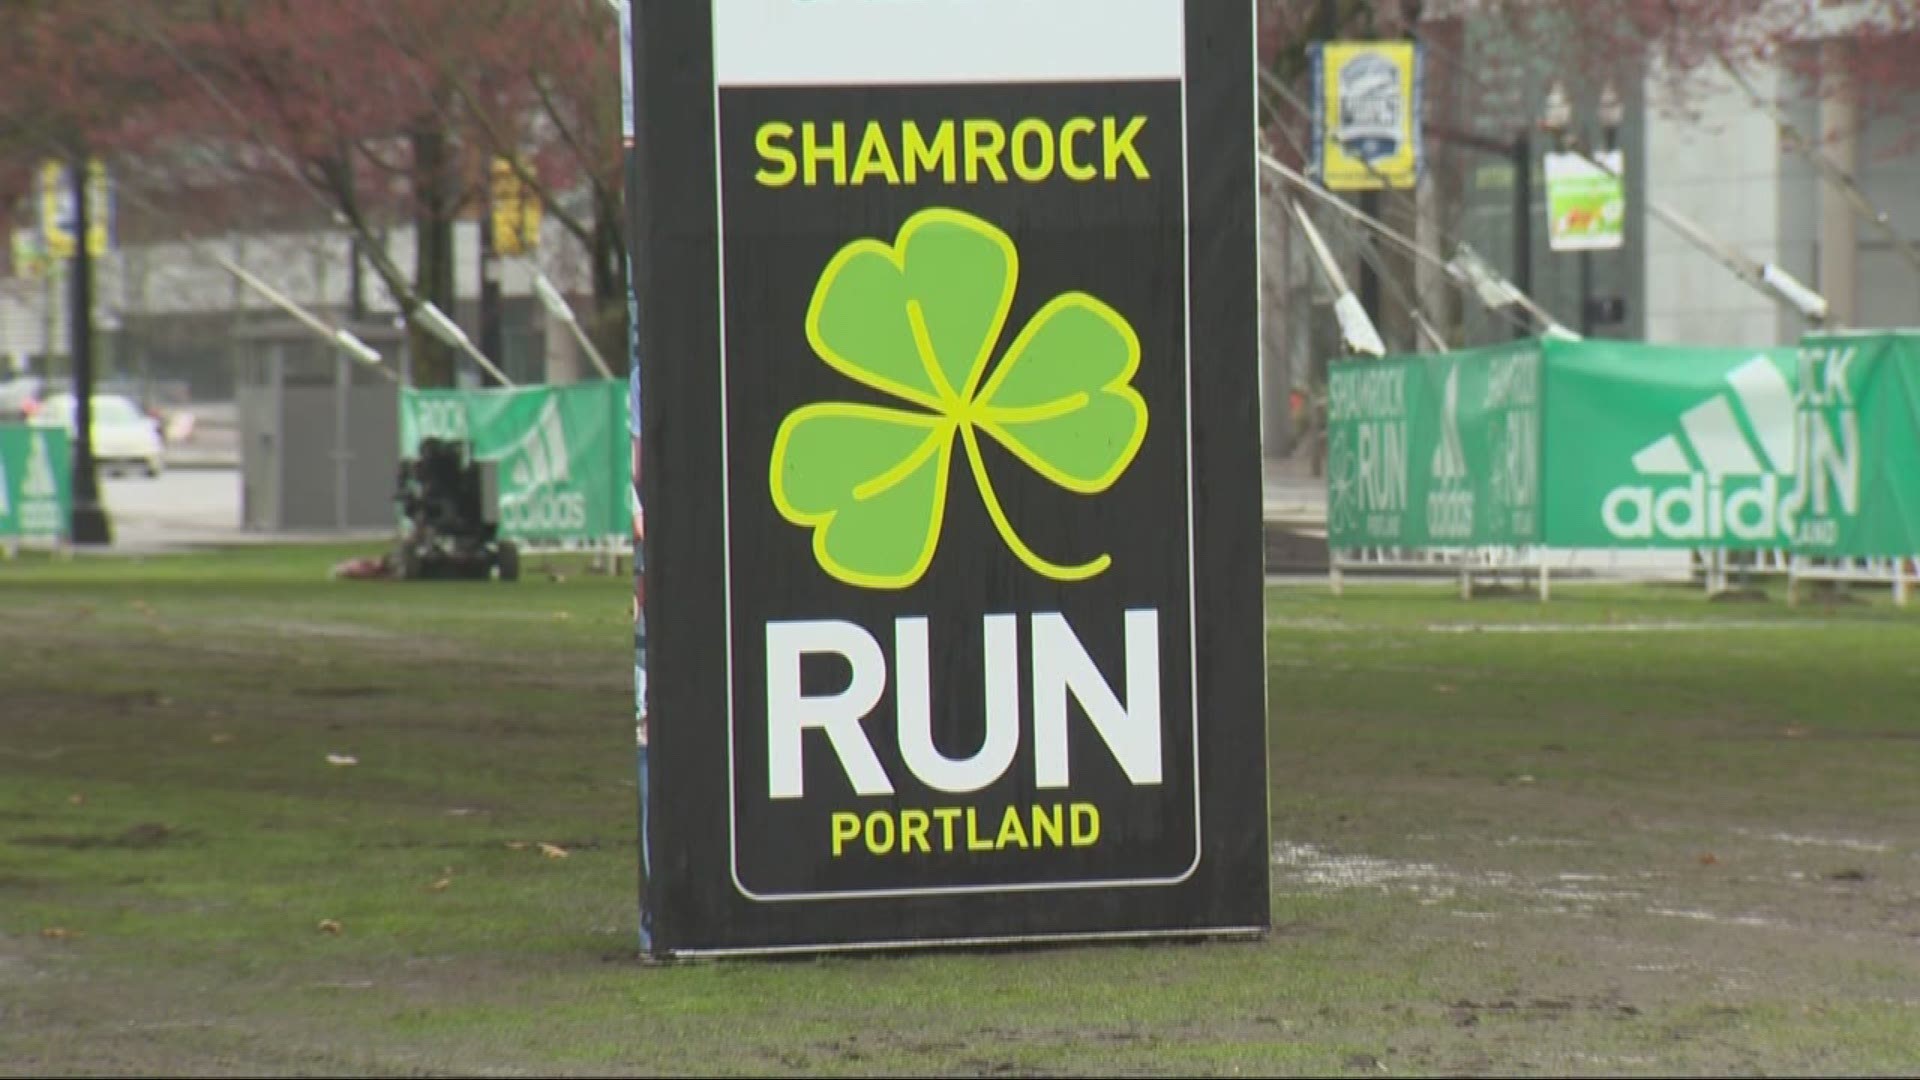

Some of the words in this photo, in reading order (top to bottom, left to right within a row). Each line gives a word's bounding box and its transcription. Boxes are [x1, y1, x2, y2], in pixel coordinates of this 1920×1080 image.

[754, 114, 1151, 187] SHAMROCK
[1358, 415, 1408, 511] RUN
[1601, 470, 1800, 540] adid
[765, 608, 1163, 799] RUN
[831, 802, 1101, 857] PORTLAND
